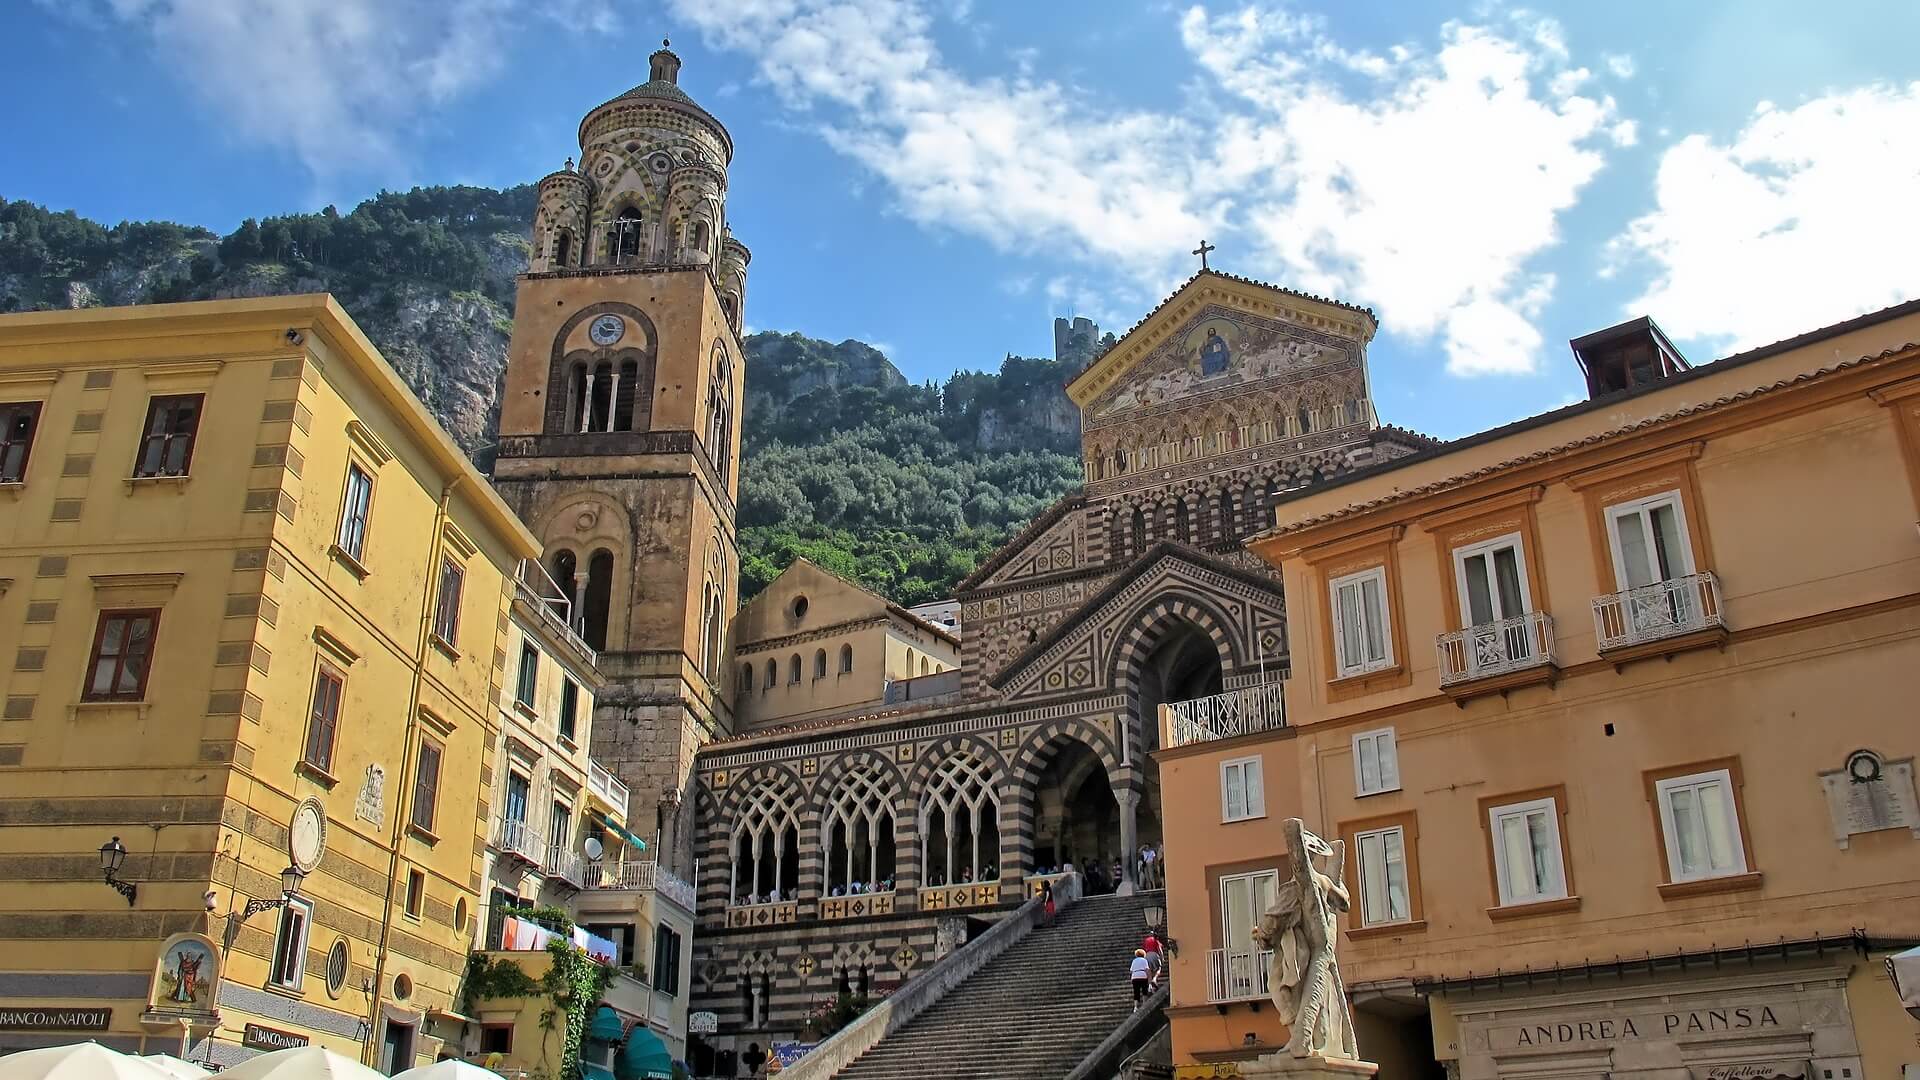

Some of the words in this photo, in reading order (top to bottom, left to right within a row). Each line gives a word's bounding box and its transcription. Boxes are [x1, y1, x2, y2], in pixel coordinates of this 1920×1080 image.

[0, 1012, 45, 1025] BANCO
[57, 1013, 105, 1026] NAPOLI
[1517, 1018, 1639, 1047] ANDREA
[1663, 1006, 1779, 1035] PANSA
[258, 1030, 281, 1046] BANCO
